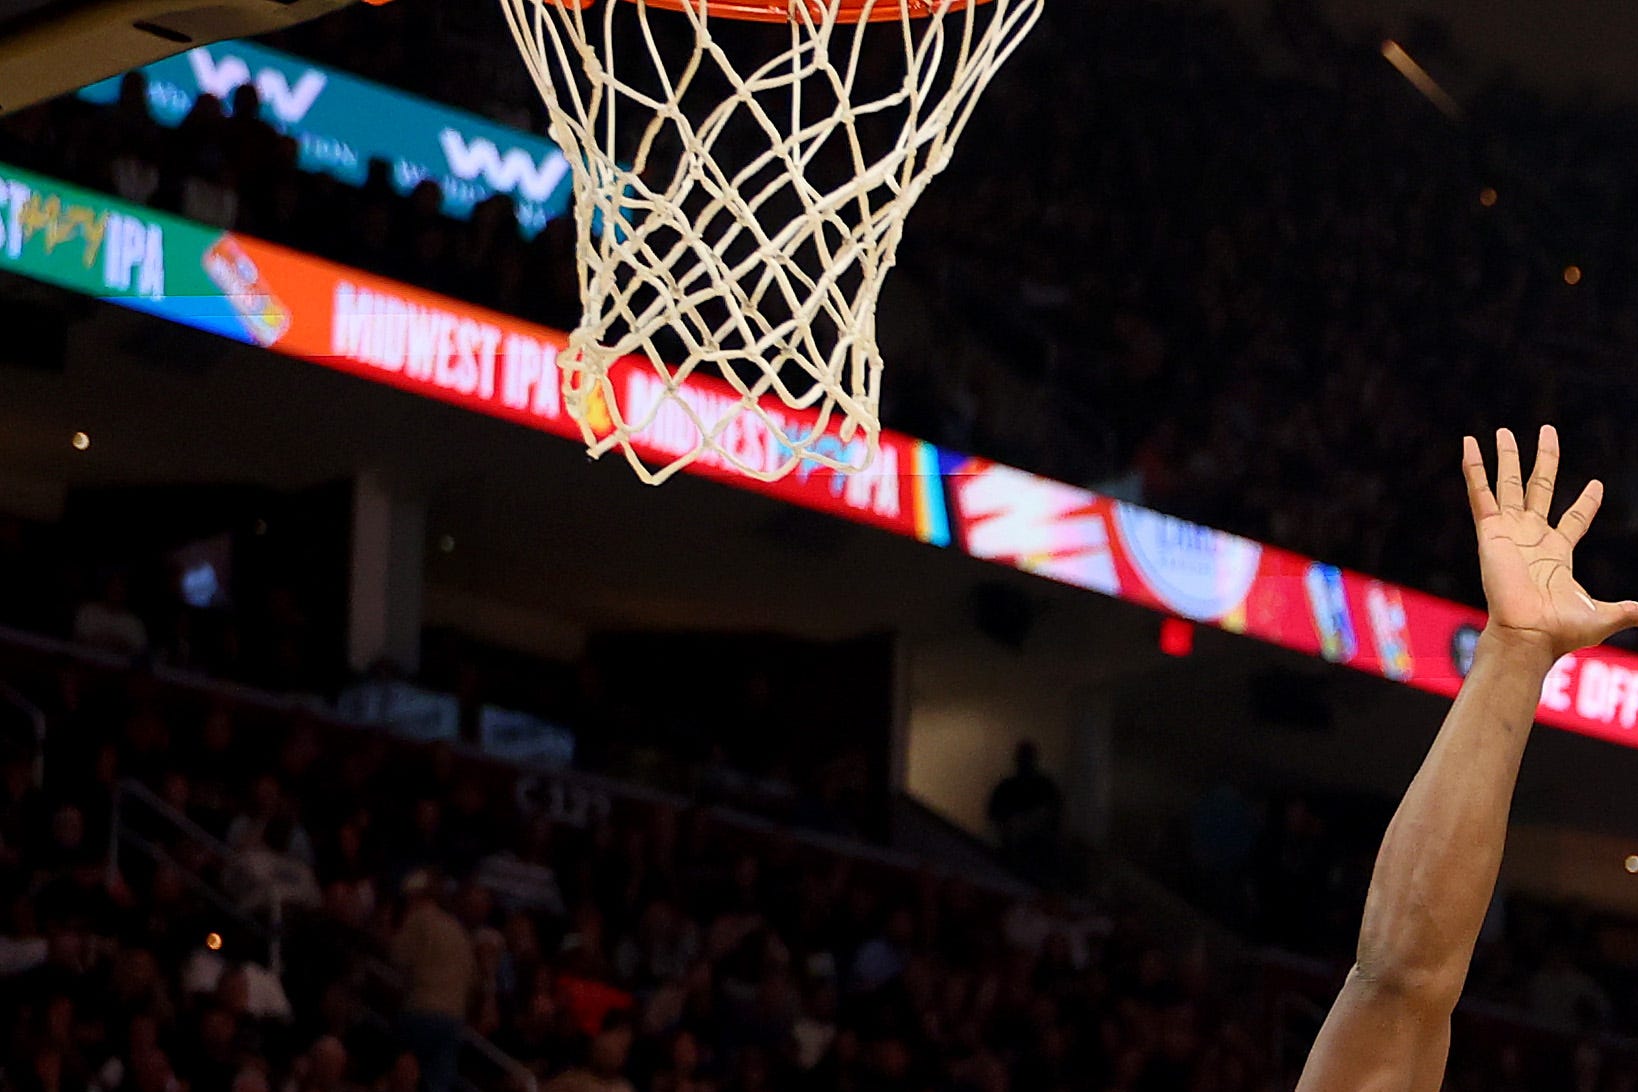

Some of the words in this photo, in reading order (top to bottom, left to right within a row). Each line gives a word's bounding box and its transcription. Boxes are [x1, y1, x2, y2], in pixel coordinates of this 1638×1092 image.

[104, 211, 165, 301] IPA
[332, 280, 502, 400] MIDWEST
[503, 333, 560, 419] IPA
